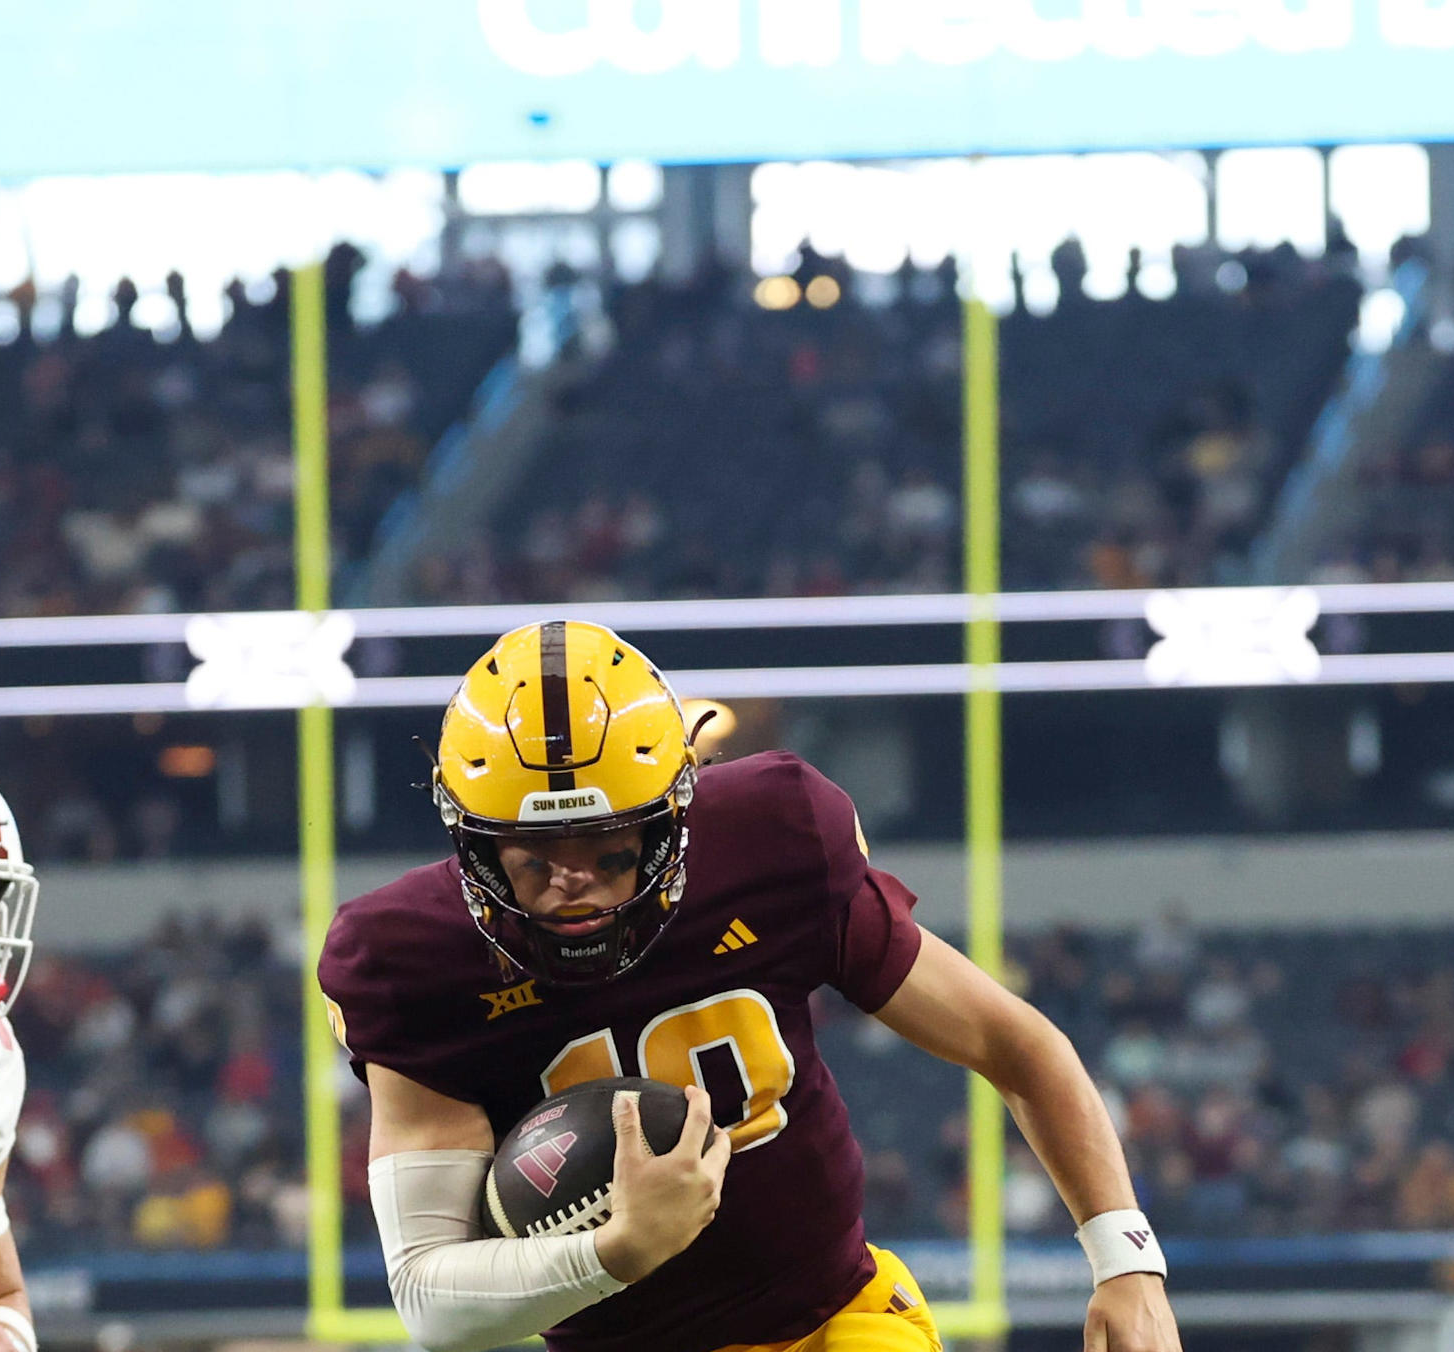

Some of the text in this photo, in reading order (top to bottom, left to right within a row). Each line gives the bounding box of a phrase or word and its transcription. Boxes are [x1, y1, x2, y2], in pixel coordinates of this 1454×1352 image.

[532, 795, 596, 812] SUN DEVILS
[560, 942, 607, 958] Riddell
[478, 978, 544, 1021] XII
